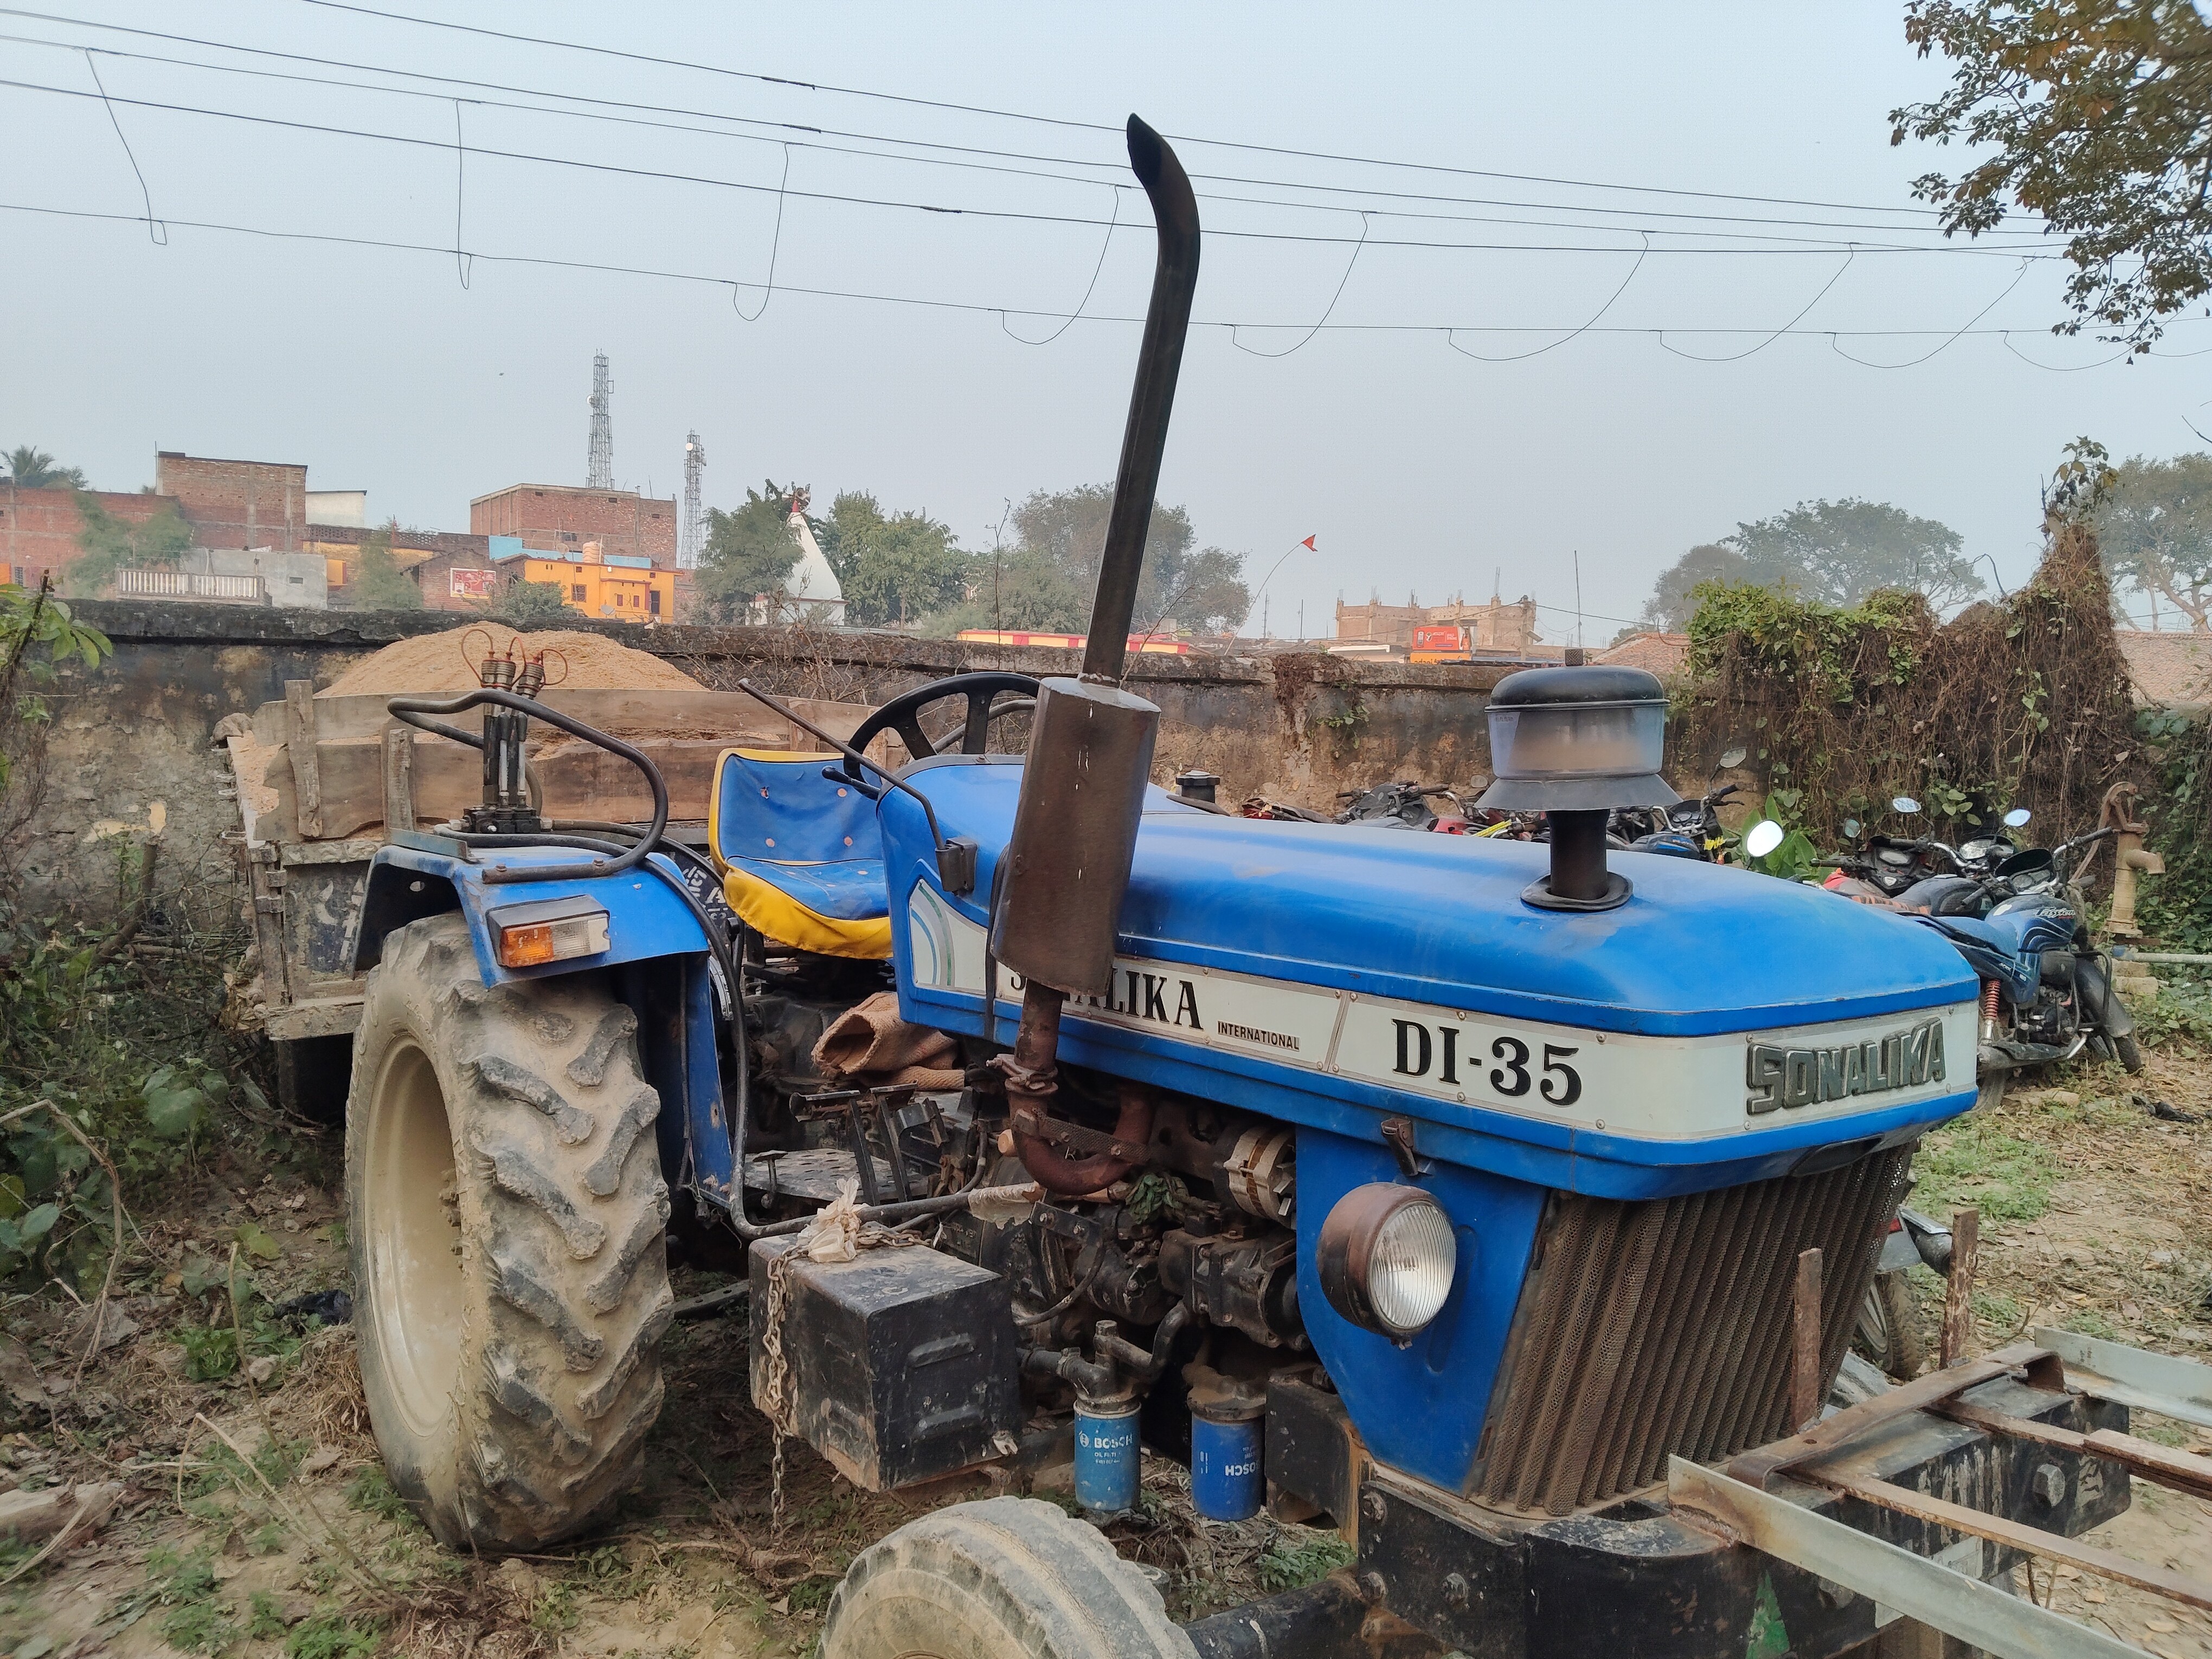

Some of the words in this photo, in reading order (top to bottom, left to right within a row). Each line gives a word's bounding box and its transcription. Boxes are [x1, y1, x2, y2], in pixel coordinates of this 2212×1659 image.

[1011, 967, 1204, 1031] LIKA
[1218, 1021, 1300, 1051] INTERNATIONAL
[1392, 1018, 1582, 1107] DI-35
[1746, 1017, 1947, 1115] SONALIKA
[1094, 1433, 1133, 1449] BOSCH
